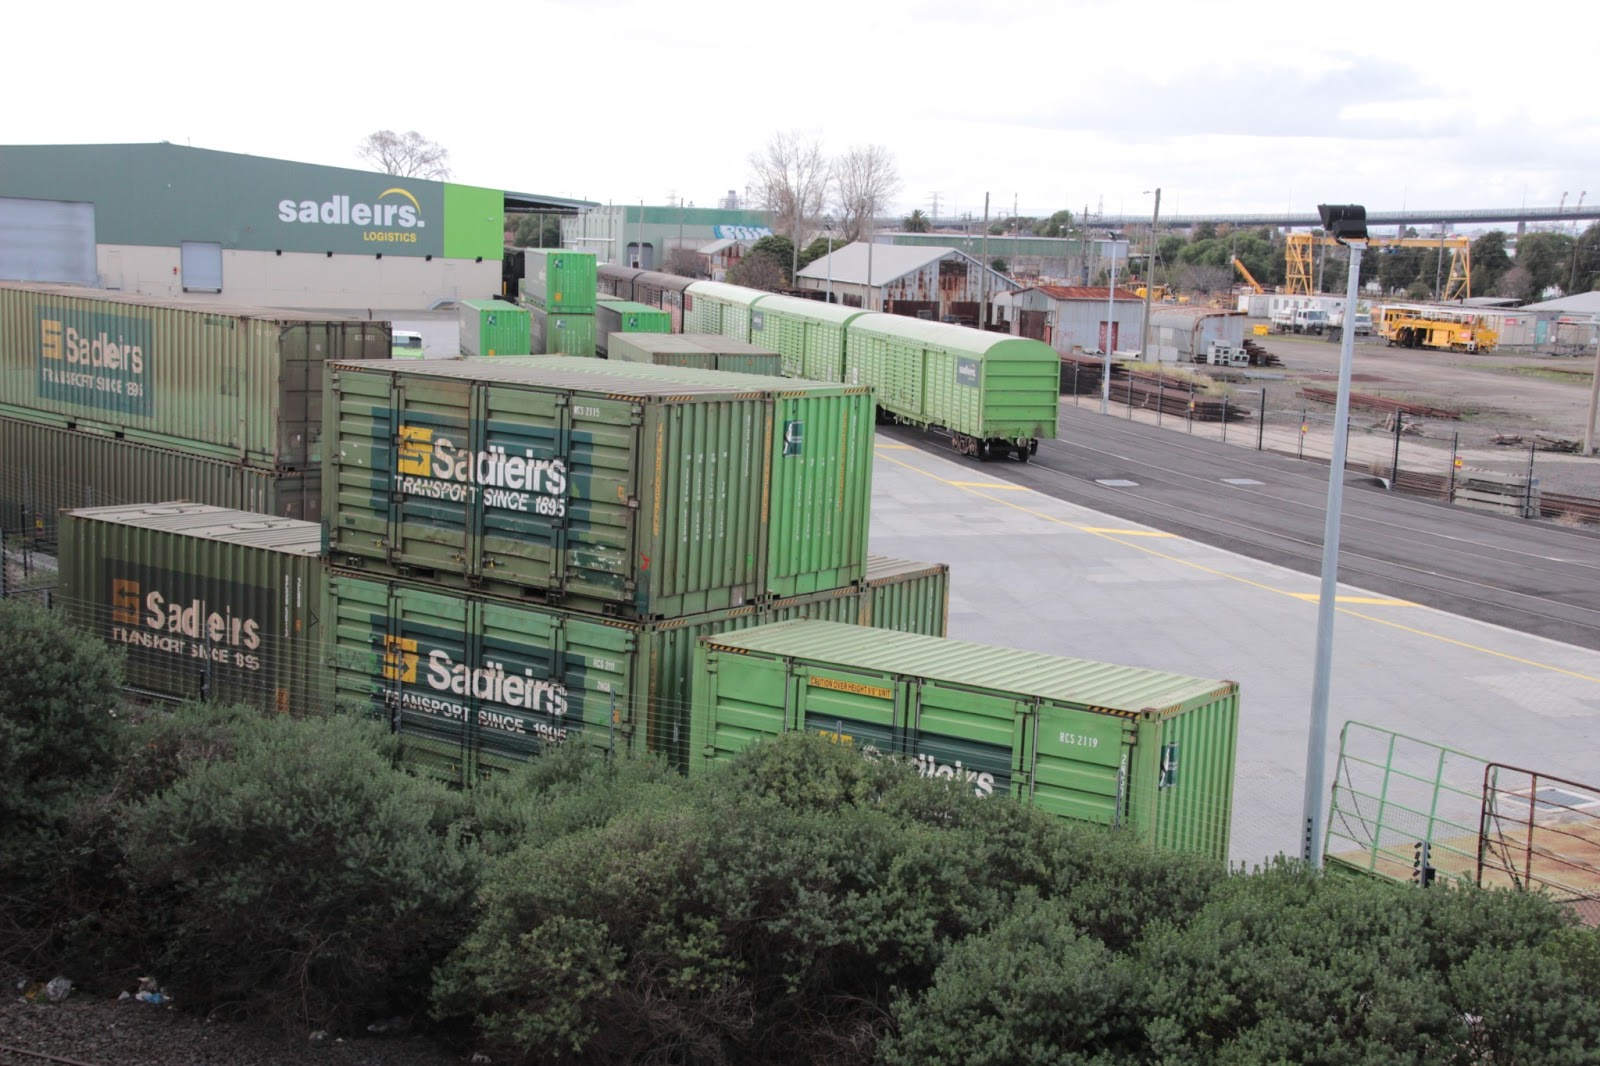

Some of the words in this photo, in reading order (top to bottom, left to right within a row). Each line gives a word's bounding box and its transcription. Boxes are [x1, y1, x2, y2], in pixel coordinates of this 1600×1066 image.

[363, 231, 417, 243] LOGISTICS
[66, 327, 143, 373] Sadleirs
[96, 376, 122, 394] SINCE
[432, 438, 567, 495] Sadleirs
[394, 475, 479, 504] TRANSPORT
[483, 487, 530, 512] SINCE
[535, 495, 566, 518] 1895
[146, 591, 260, 650] Sadleirs
[112, 627, 186, 655] TRANSPORT
[191, 644, 229, 664] SINCE
[427, 649, 568, 716] Sadleirs
[810, 676, 833, 688] CAUTION
[834, 681, 848, 690] OVER
[847, 682, 867, 694] HEIGHT
[878, 688, 891, 698] UNIT
[478, 710, 526, 734] SINCE
[1060, 731, 1075, 745] RCS
[1077, 735, 1098, 748] 2119
